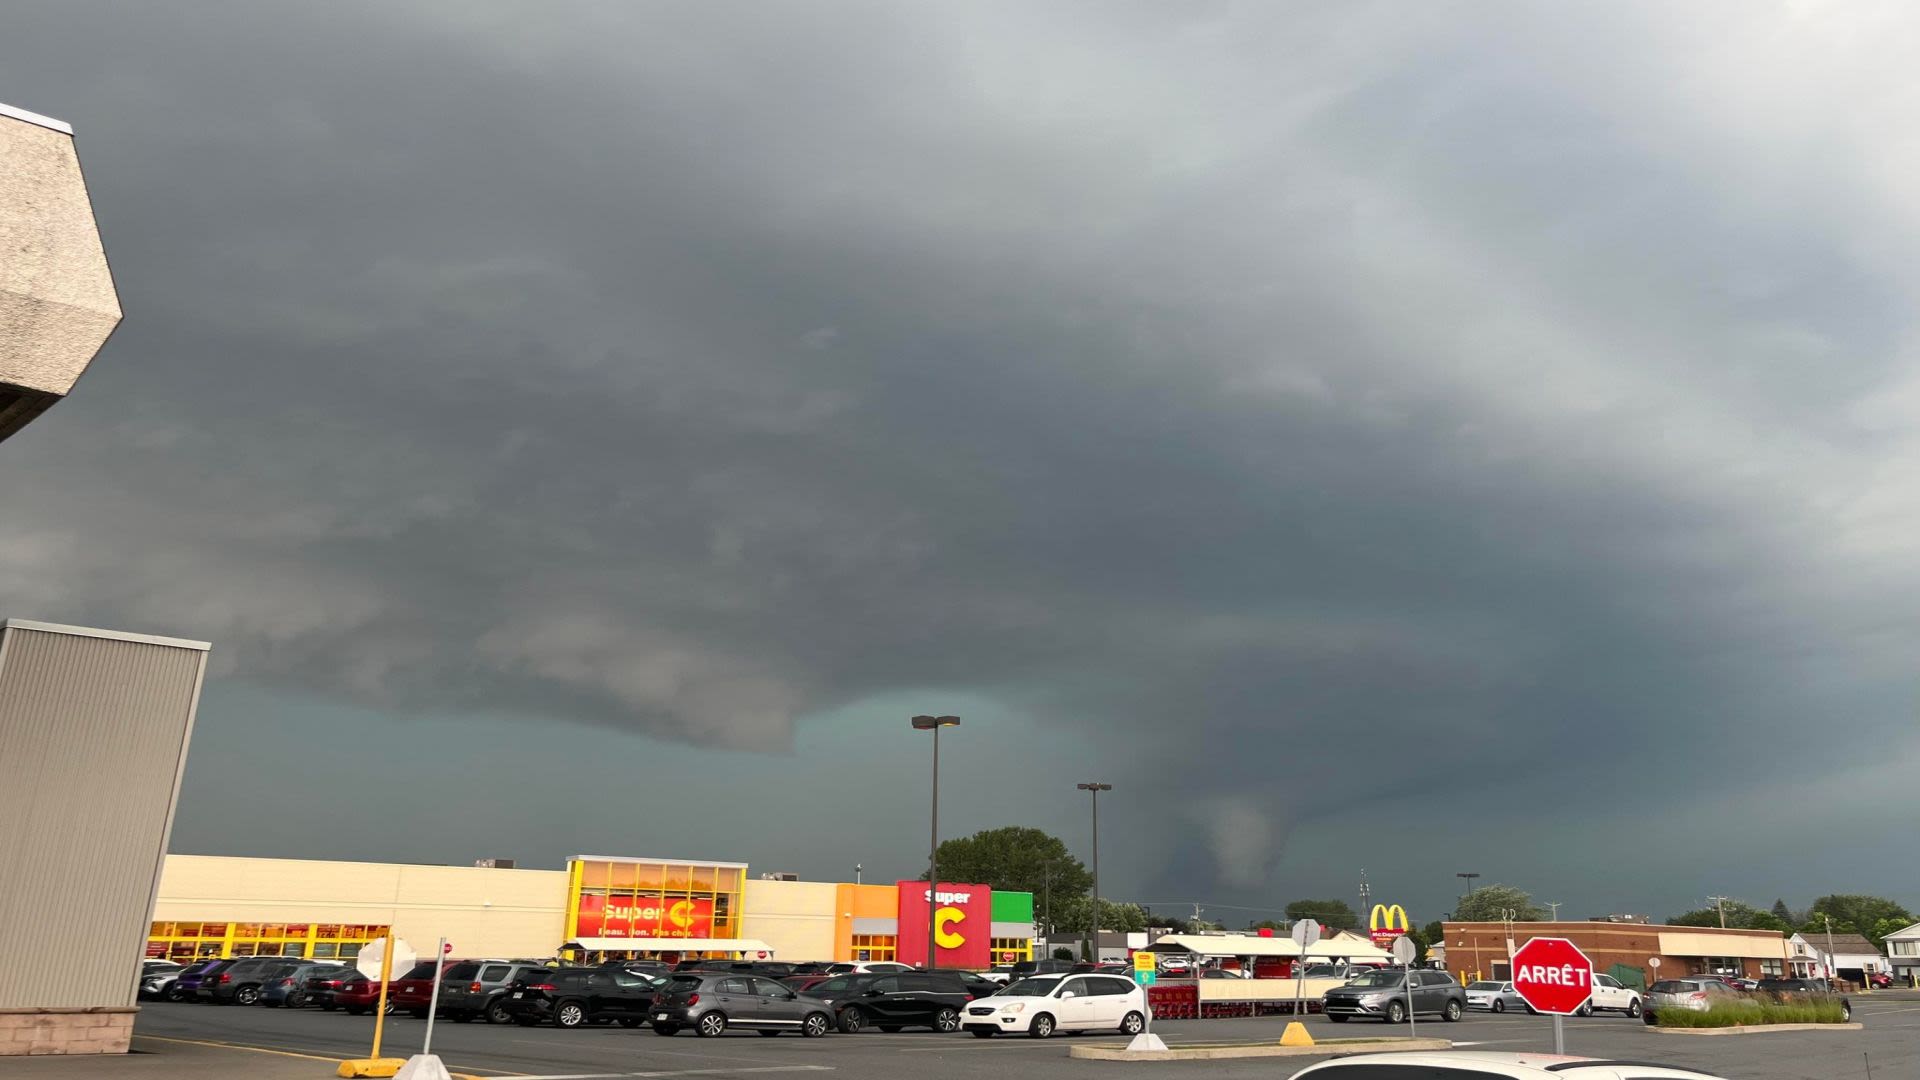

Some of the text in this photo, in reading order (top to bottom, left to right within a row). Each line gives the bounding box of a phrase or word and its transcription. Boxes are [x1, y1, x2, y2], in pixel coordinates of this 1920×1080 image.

[601, 900, 696, 928] Super C
[928, 906, 966, 949] C
[1517, 963, 1588, 987] ARRÊT
